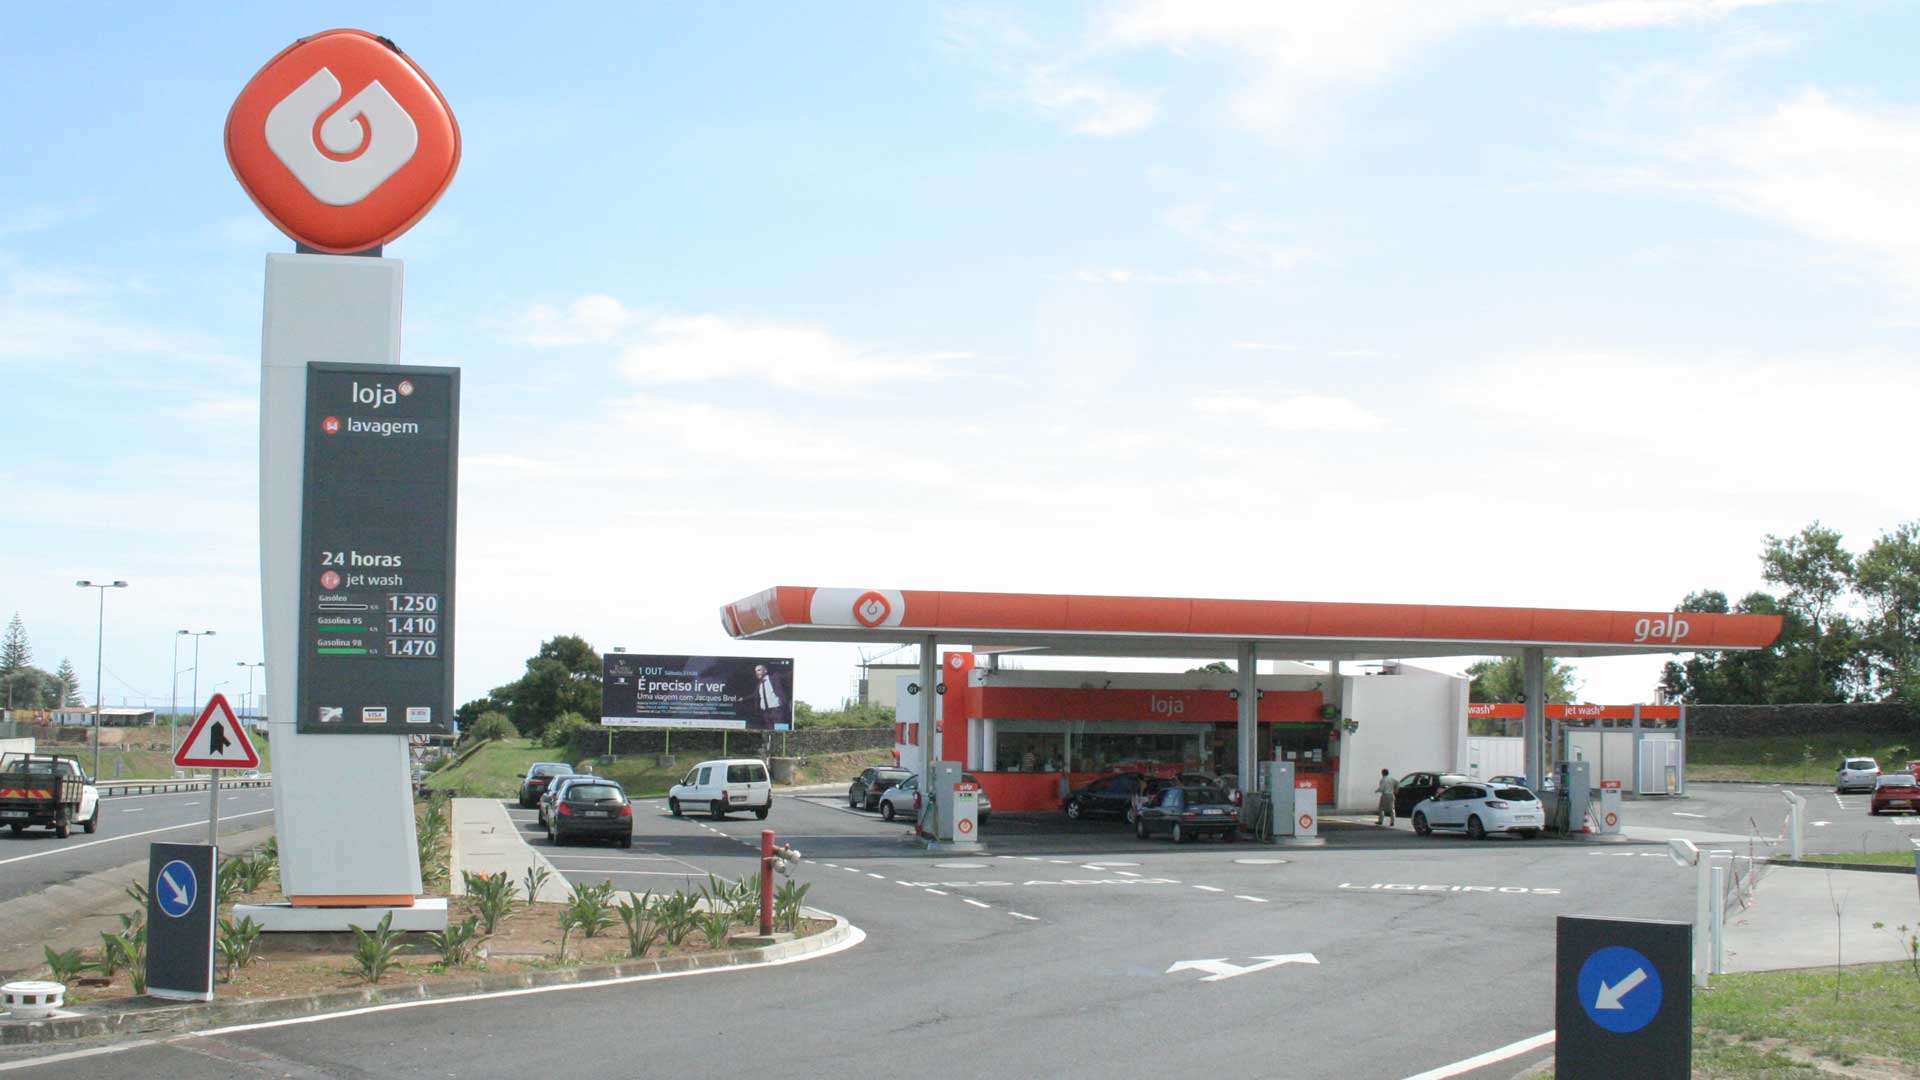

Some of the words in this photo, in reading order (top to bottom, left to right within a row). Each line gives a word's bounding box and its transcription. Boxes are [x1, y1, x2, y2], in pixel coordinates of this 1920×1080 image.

[353, 381, 397, 408] loja
[347, 417, 418, 436] lavagem
[321, 551, 345, 566] 24
[351, 551, 402, 567] horas
[346, 574, 364, 587] jet
[368, 574, 403, 586] wash
[319, 594, 347, 602] Gasóleo
[389, 596, 437, 611] 1.250
[318, 616, 350, 625] Gasolina
[352, 617, 362, 625] 95
[388, 618, 436, 633] 1.410
[1634, 614, 1690, 642] galp
[317, 638, 350, 646] Gasolina
[388, 640, 436, 656] 1.470
[645, 667, 663, 675] OUT
[638, 675, 646, 691] É
[649, 679, 692, 693] preciso
[694, 680, 704, 692] ir
[706, 683, 725, 692] ver
[637, 692, 653, 700] Uma
[653, 693, 678, 702] viagem
[694, 693, 722, 703] Jacques
[723, 694, 737, 702] Brel
[1151, 695, 1185, 716] loja
[1468, 704, 1490, 714] wash
[1565, 705, 1576, 716] jet
[1578, 706, 1600, 715] wash
